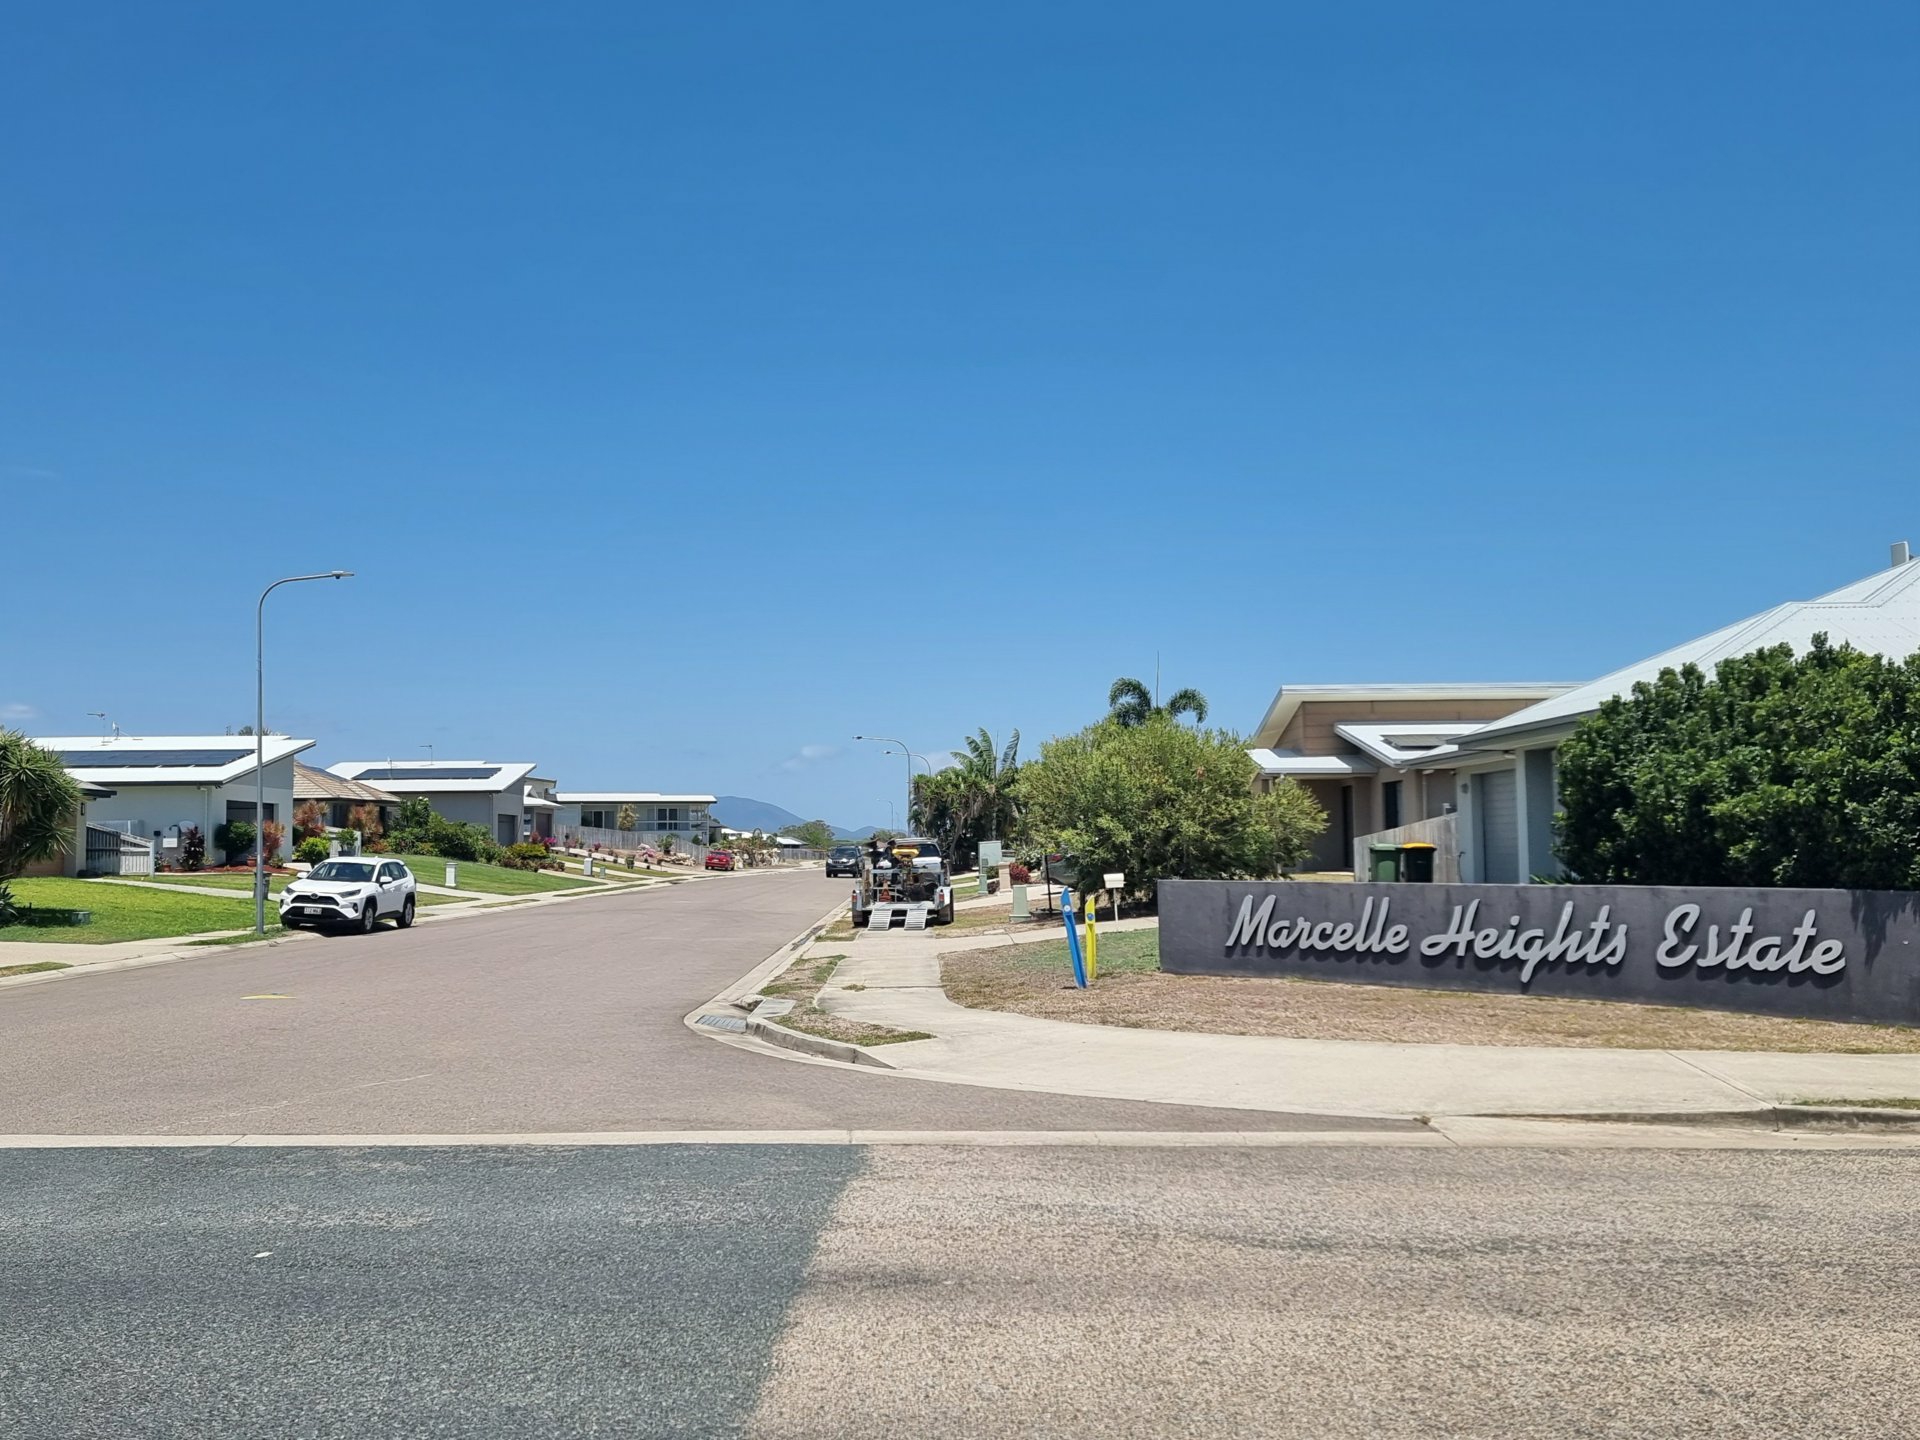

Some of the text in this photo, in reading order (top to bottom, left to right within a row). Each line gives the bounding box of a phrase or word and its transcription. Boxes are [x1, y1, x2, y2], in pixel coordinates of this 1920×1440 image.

[1226, 894, 1846, 983] Marcelle Heights Estate
